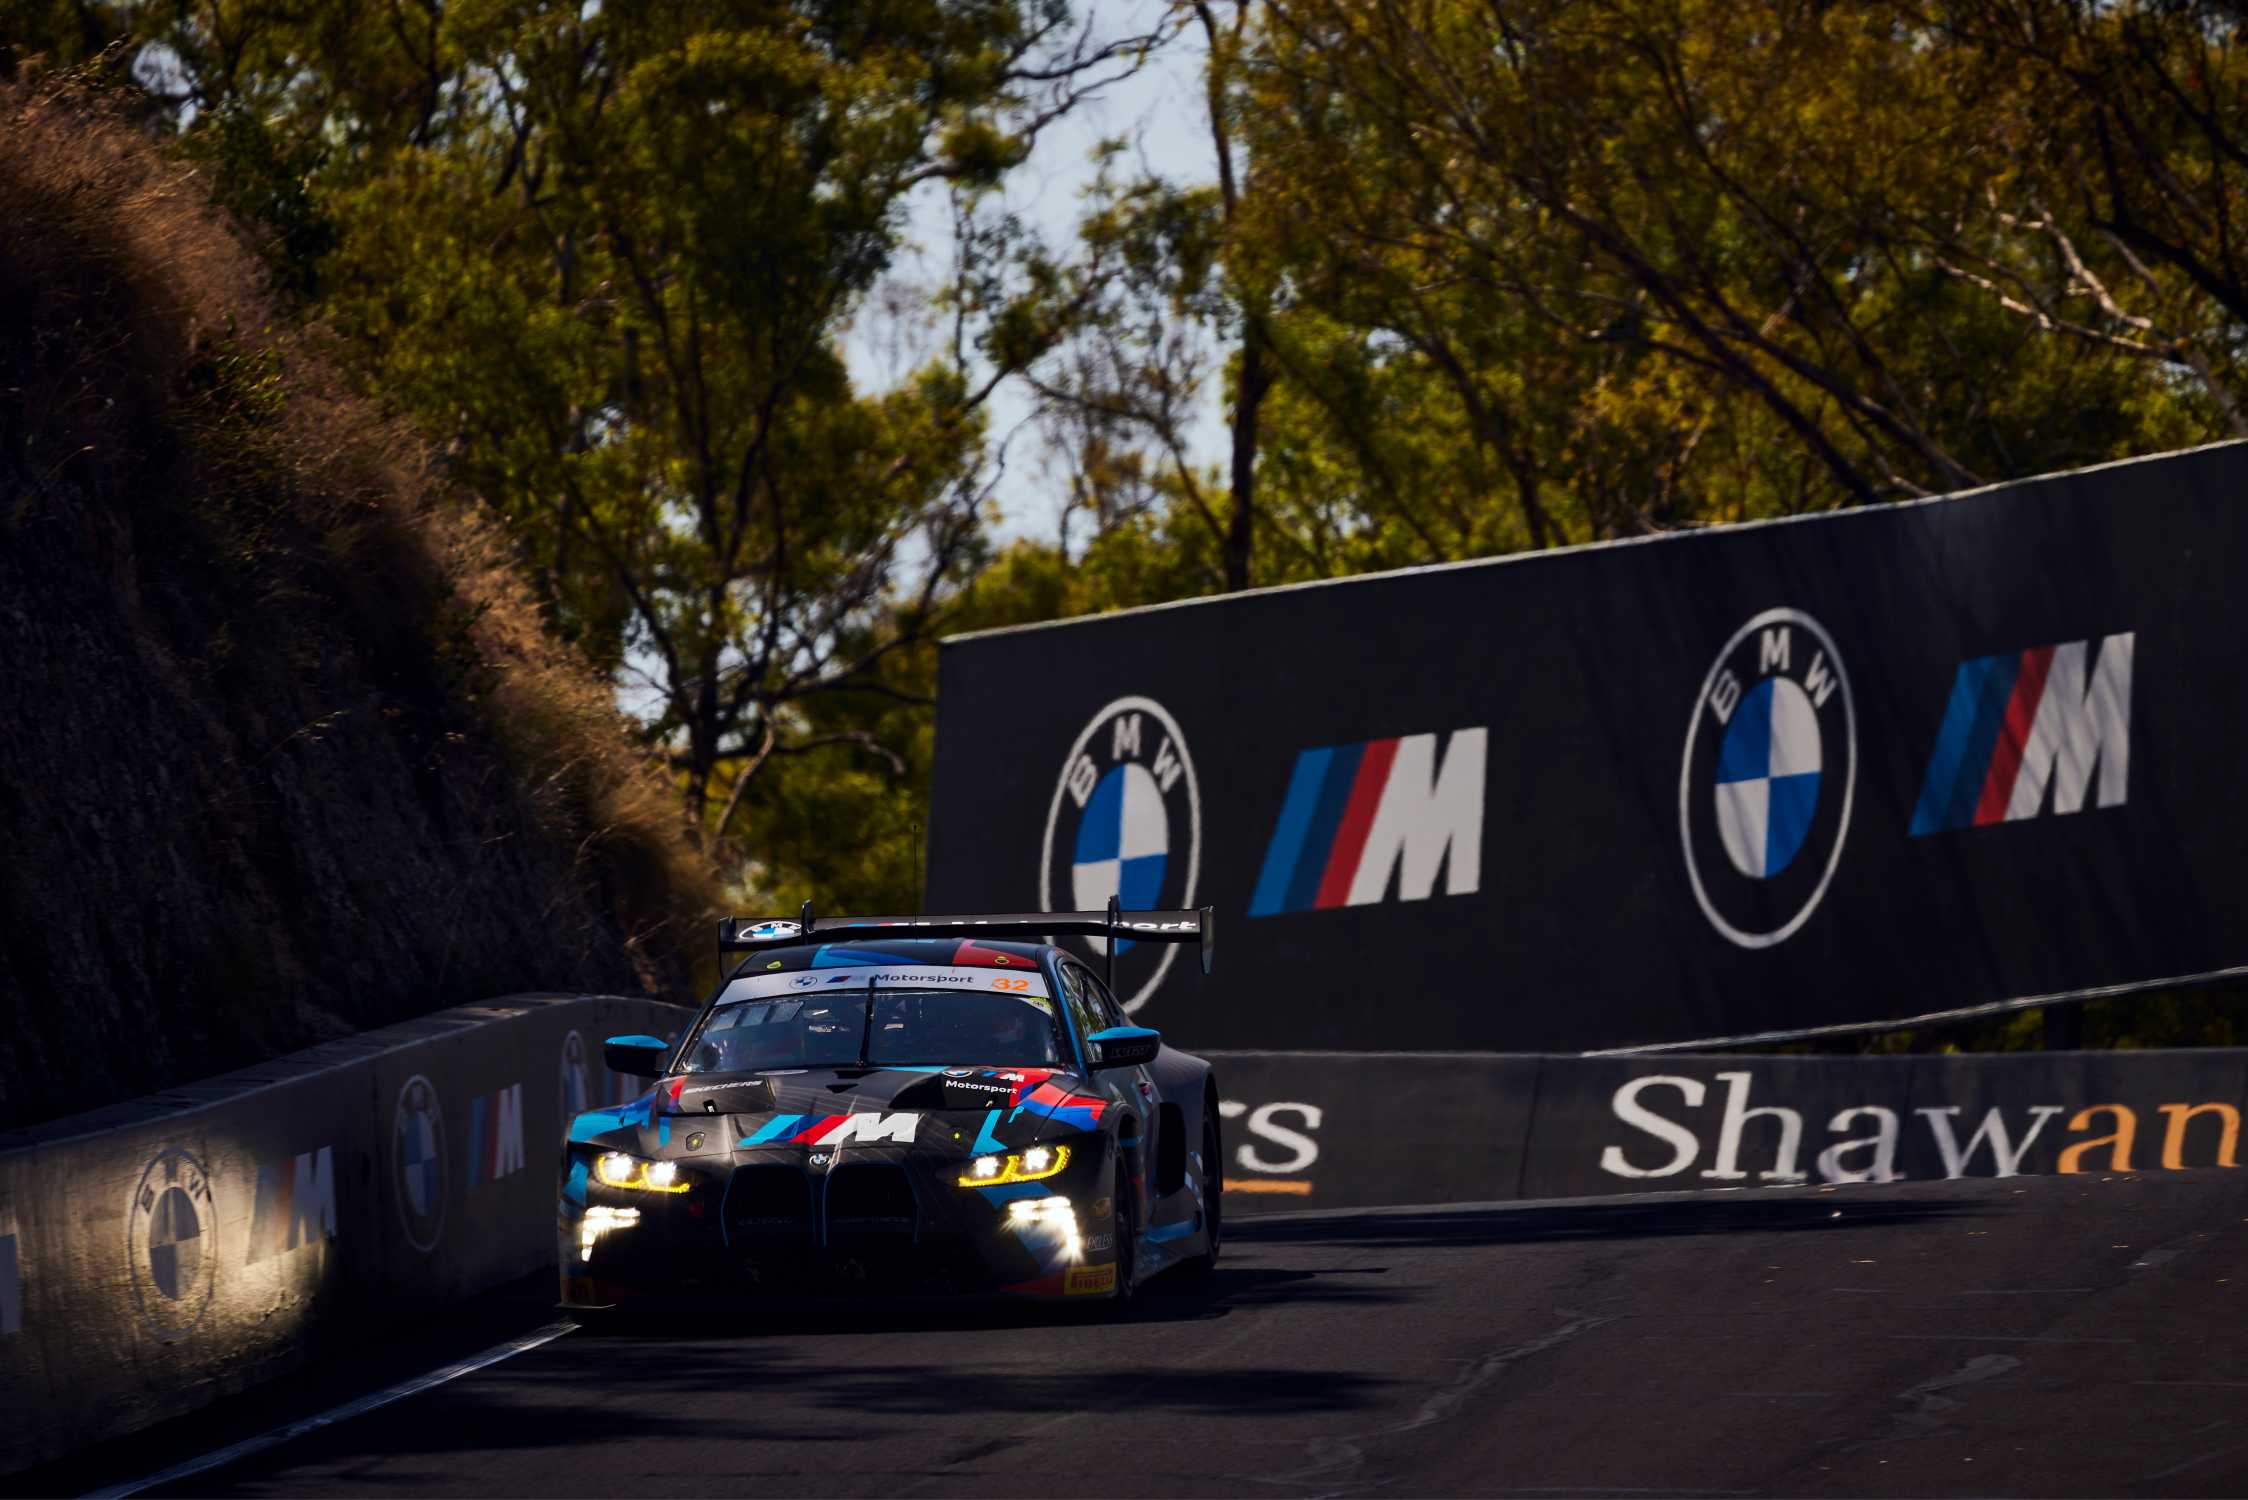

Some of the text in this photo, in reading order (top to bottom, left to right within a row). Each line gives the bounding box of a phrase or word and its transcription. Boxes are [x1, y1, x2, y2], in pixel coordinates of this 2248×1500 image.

[1709, 625, 1838, 726] BMW
[1068, 712, 1182, 808] BMW
[2003, 630, 2136, 823] M
[1344, 726, 1489, 908] M
[873, 974, 1029, 991] Motorsport 32
[812, 1112, 919, 1146] M
[945, 1080, 1018, 1095] Motorsport
